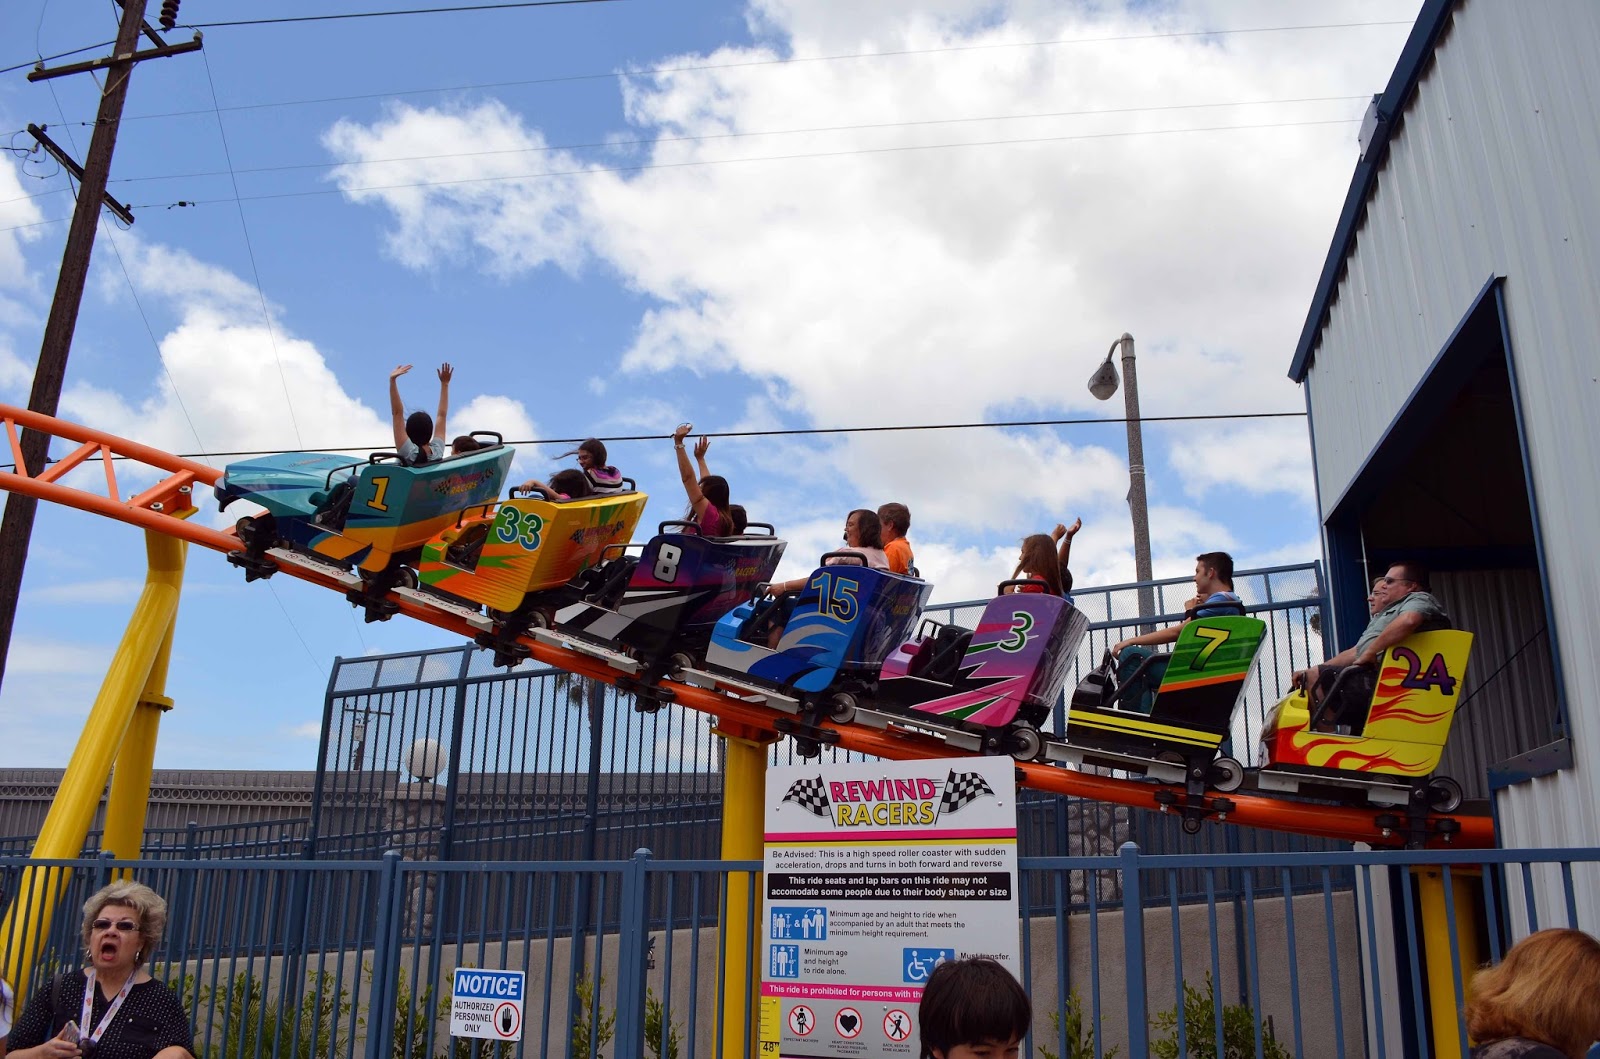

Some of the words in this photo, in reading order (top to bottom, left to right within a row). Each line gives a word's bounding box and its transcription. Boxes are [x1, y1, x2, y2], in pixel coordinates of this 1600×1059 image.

[366, 476, 390, 512] 1
[496, 505, 543, 552] 33
[652, 542, 683, 584] 8
[812, 572, 858, 622] 15
[997, 611, 1034, 653] 3
[1189, 626, 1231, 672] 7
[1392, 646, 1456, 696] 24
[830, 778, 936, 802] REWIND
[838, 802, 935, 826] RACERS
[853, 850, 870, 859] high
[872, 850, 896, 859] speed
[825, 861, 847, 870] drops
[789, 876, 805, 884] This
[808, 876, 822, 884] ride
[866, 876, 878, 886] lap
[914, 876, 930, 884] this
[933, 876, 949, 884] ride
[952, 878, 970, 886] may
[845, 888, 872, 897] people
[925, 888, 946, 897] body
[949, 888, 975, 898] shape
[990, 888, 1007, 896] size
[890, 911, 912, 919] height
[794, 920, 800, 928] &
[457, 974, 519, 996] NOTICE
[810, 987, 848, 996] prohibited
[454, 1001, 495, 1011] AUTHORIZED
[454, 1012, 492, 1022] PERSONNEL
[464, 1024, 481, 1032] ONLY
